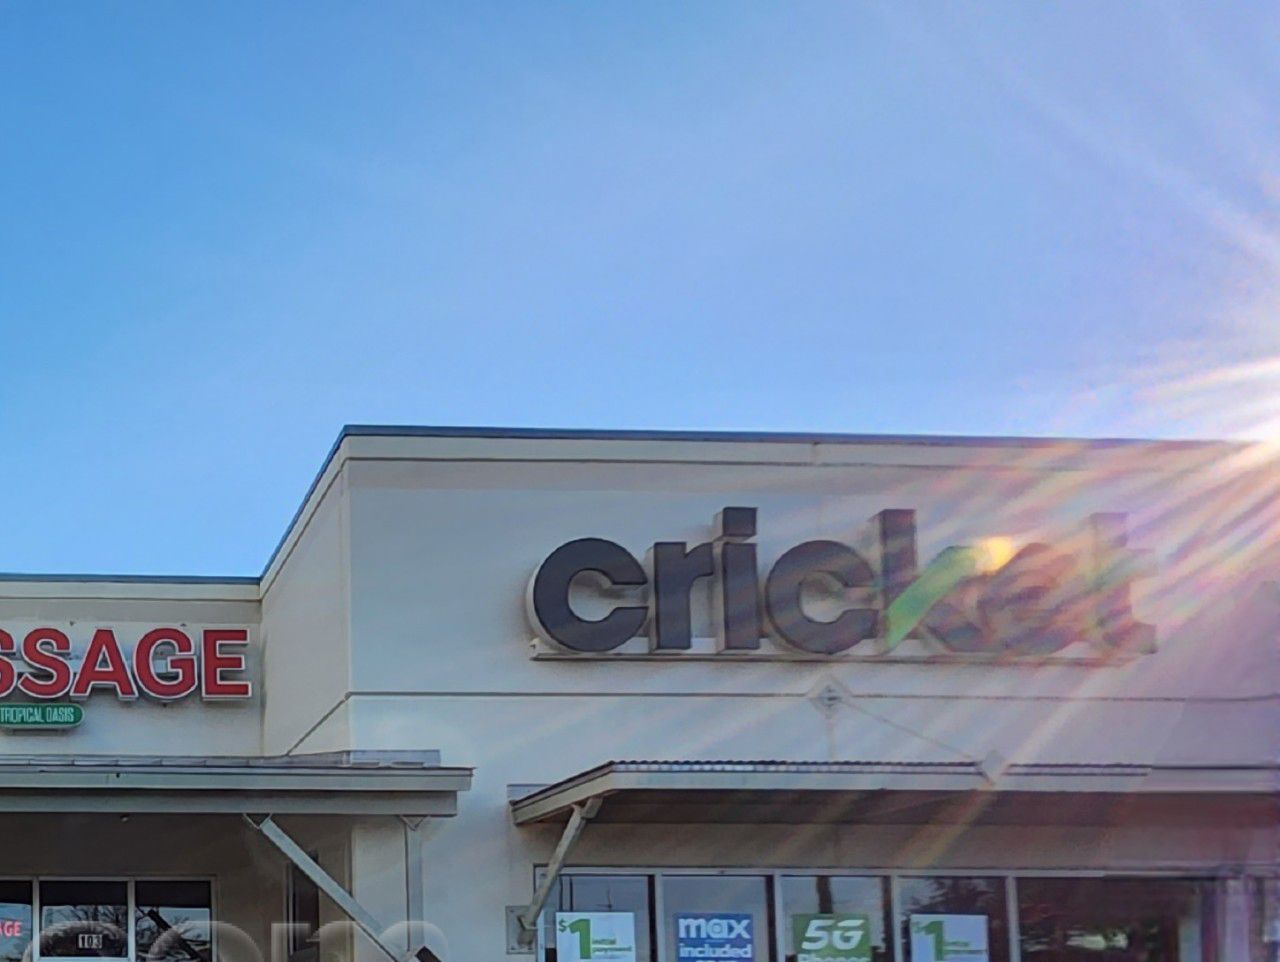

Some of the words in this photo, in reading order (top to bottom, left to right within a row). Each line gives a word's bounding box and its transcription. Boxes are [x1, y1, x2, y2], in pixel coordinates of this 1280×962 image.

[531, 506, 1158, 655] cricket
[0, 706, 44, 723] TROPICAL
[46, 706, 75, 723] OASIS
[678, 918, 752, 939] max
[801, 919, 865, 950] 5G
[679, 943, 752, 958] included
